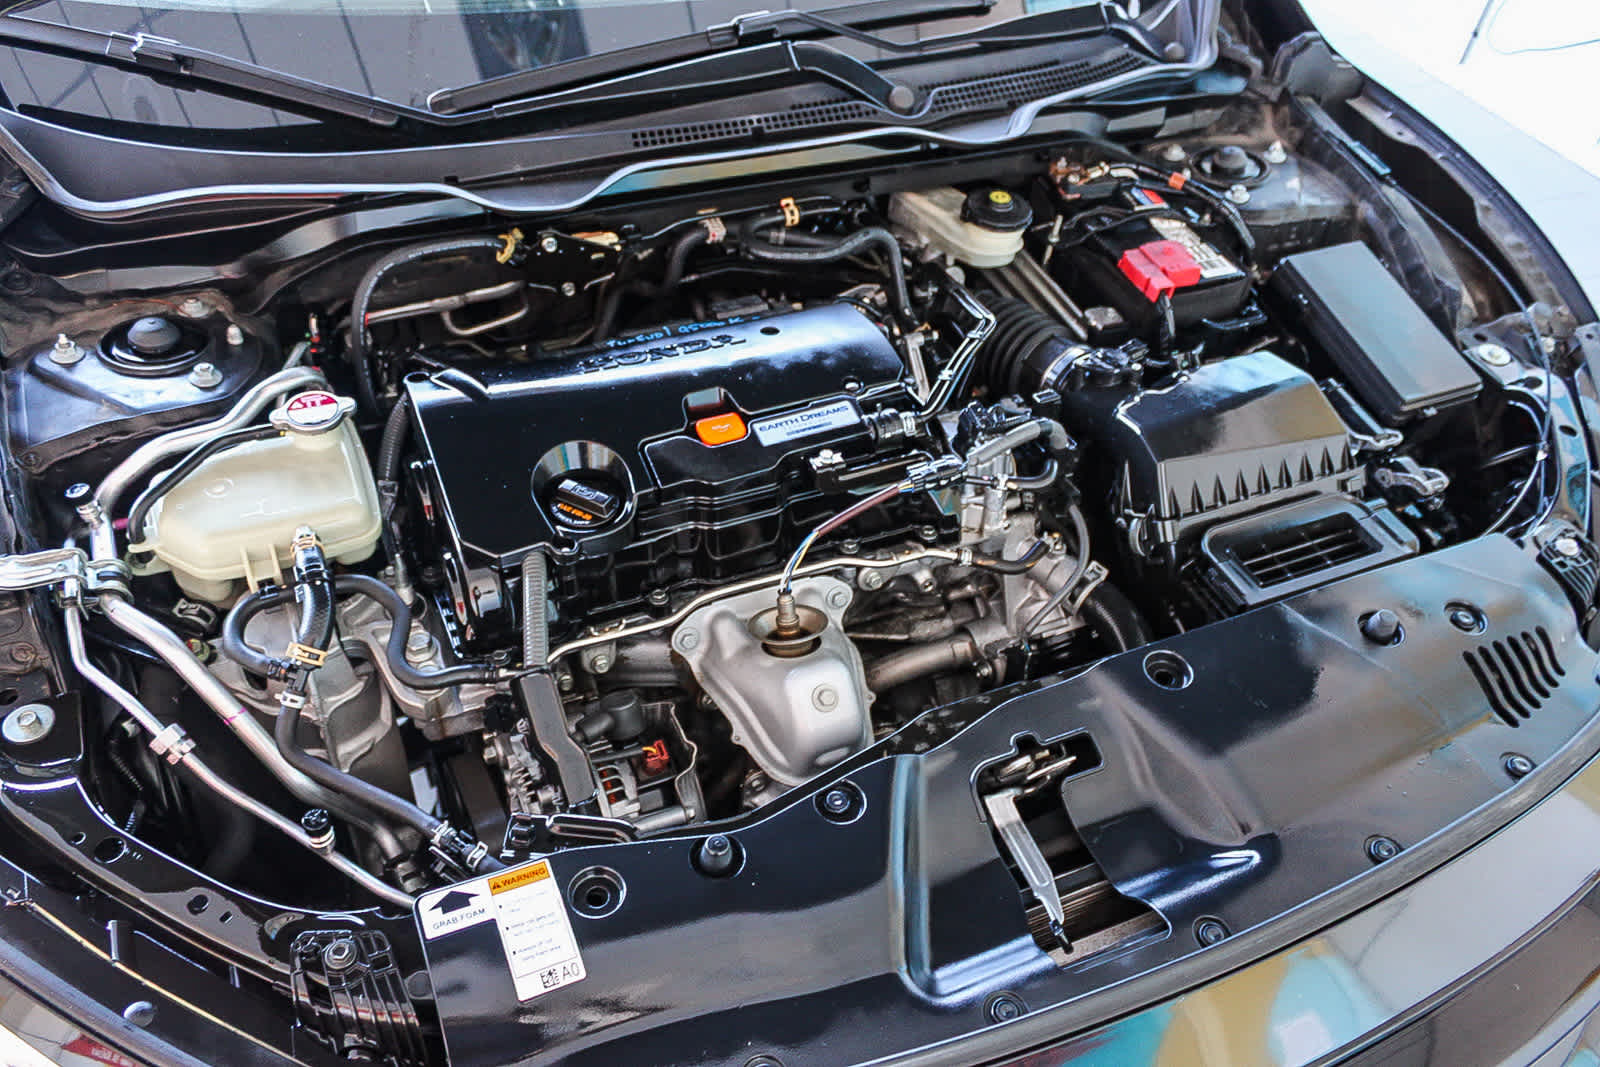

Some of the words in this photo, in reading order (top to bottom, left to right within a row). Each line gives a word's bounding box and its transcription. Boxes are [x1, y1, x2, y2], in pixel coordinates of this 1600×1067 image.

[577, 334, 746, 373] HONDA
[758, 417, 799, 432] EARTH
[501, 867, 547, 889] WARNING
[432, 915, 458, 930] GRAB
[458, 907, 486, 922] FOAM
